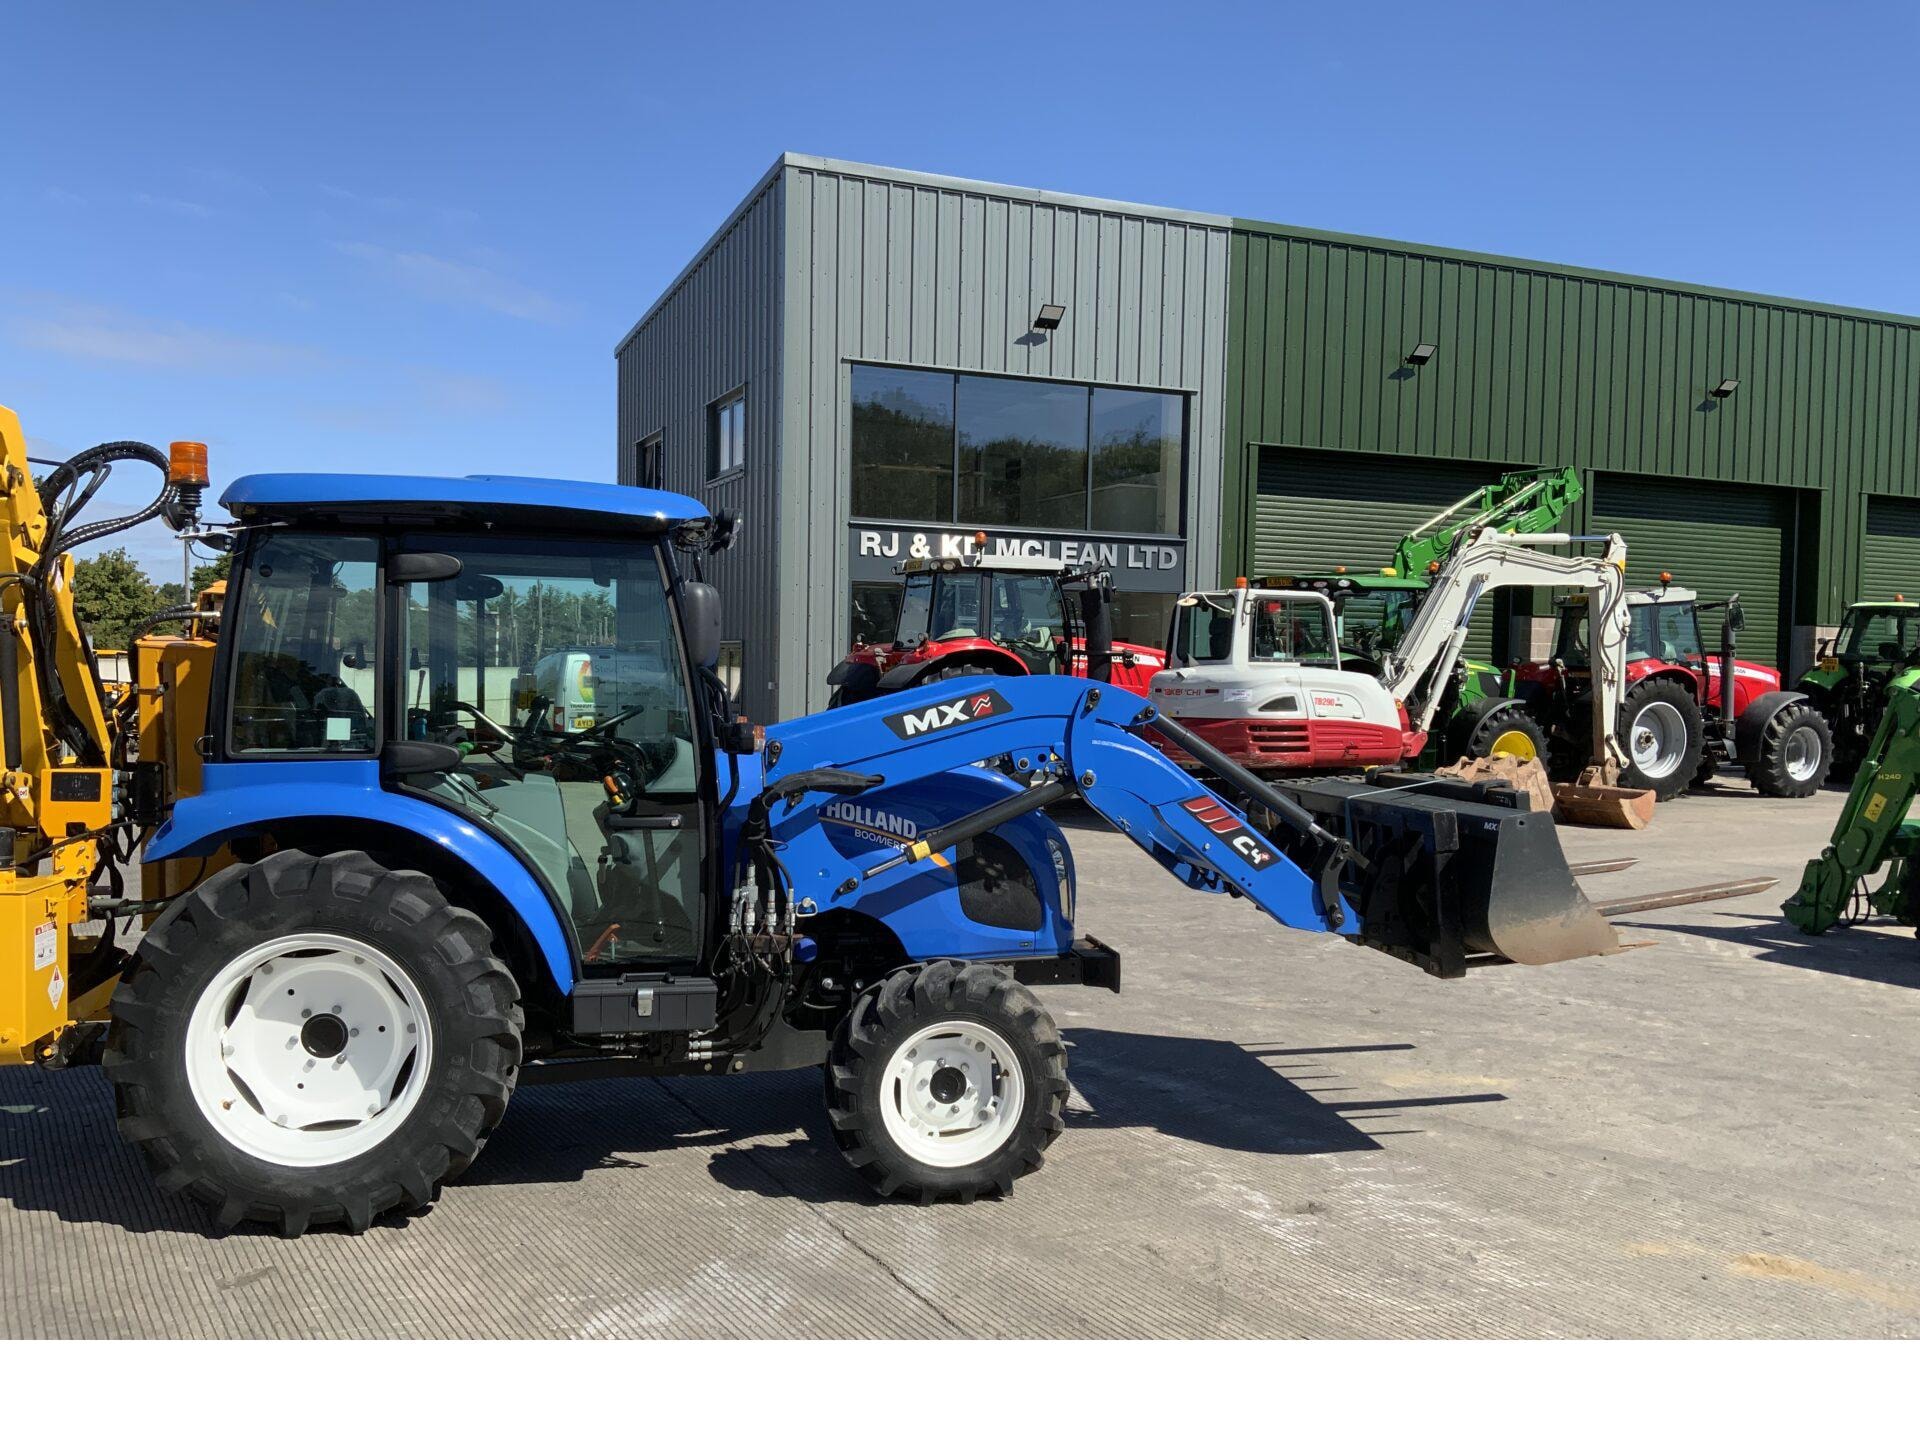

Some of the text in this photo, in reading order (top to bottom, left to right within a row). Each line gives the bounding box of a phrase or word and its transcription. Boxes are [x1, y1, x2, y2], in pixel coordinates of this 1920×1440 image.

[860, 531, 899, 557] RJ
[909, 533, 933, 558] &
[995, 538, 1118, 567] MCLEAN
[1128, 545, 1178, 570] LTD
[902, 699, 970, 736] MX
[826, 802, 917, 840] HOLLAND
[1483, 821, 1498, 831] MX
